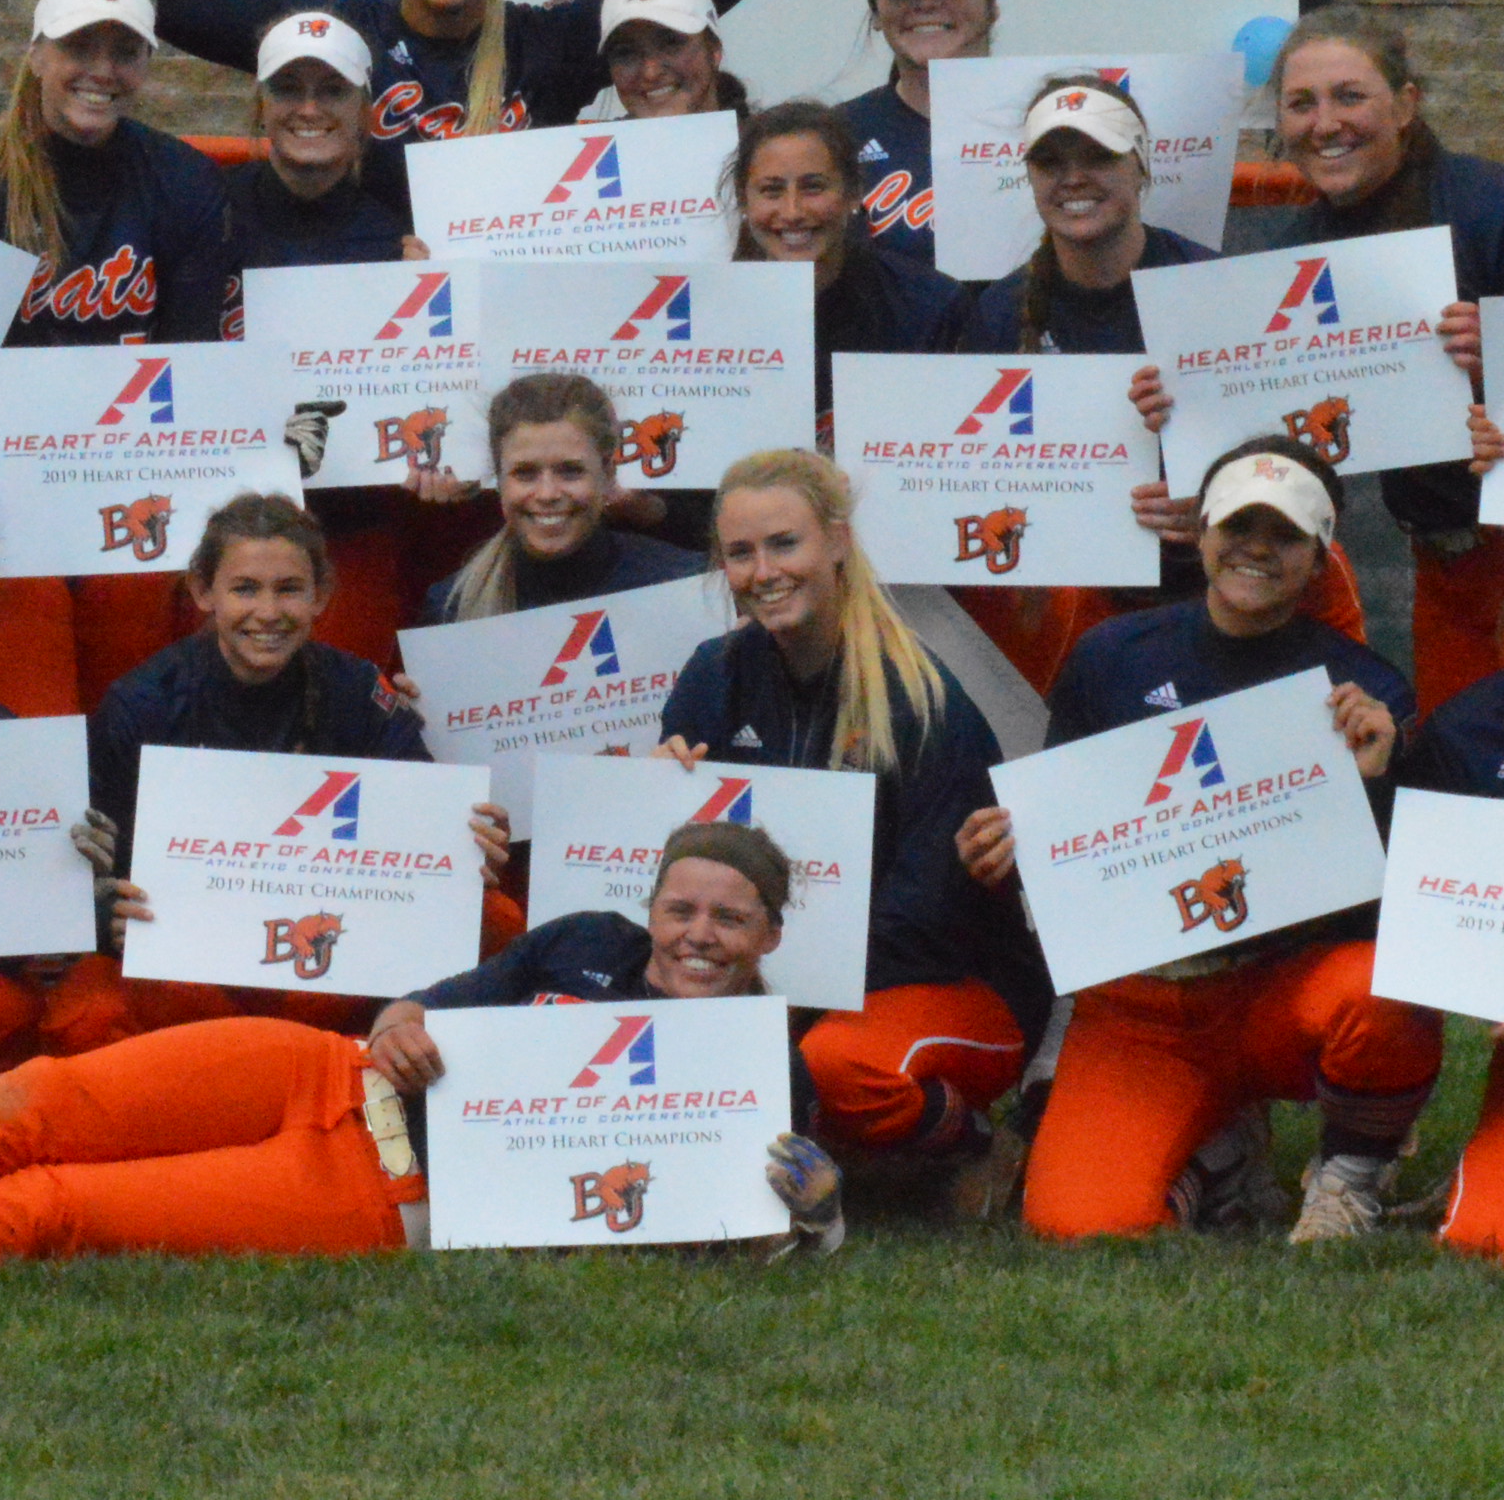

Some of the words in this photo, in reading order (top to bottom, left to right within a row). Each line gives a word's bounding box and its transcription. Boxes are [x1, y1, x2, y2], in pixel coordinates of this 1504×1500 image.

[449, 212, 544, 235] HEART
[551, 209, 578, 222] OF
[583, 197, 716, 223] AMERICA
[1178, 341, 1267, 370] HEART
[1274, 337, 1300, 352] OF
[1306, 319, 1430, 351] AMERICA
[291, 348, 374, 367] EART
[380, 346, 408, 359] OF
[512, 347, 610, 364] HEART
[617, 348, 645, 360] OF
[649, 348, 784, 365] AMERICA
[1223, 380, 1255, 396] 2019
[1259, 373, 1307, 391] HEART
[1313, 361, 1405, 382] CHAMPIONS
[317, 384, 352, 397] 2019
[358, 382, 408, 396] HEART
[651, 384, 751, 397] CHAMPIONS
[3, 433, 97, 452] HEART
[103, 432, 130, 445] OF
[135, 428, 266, 447] AMERICA
[863, 441, 954, 458] HEART
[961, 442, 988, 455] OF
[992, 443, 1129, 460] AMERICA
[43, 470, 77, 483] 2019
[83, 469, 131, 482] HEART
[138, 467, 235, 480] CHAMPIONS
[900, 478, 933, 491] 2019
[939, 478, 987, 491] HEART
[994, 479, 1094, 493] CHAMPIONS
[447, 695, 542, 727] HEART
[550, 689, 577, 705] OF
[584, 670, 678, 702] AMERI
[494, 735, 528, 752] 2019
[1050, 815, 1148, 860] HEART
[1155, 804, 1183, 824] OF
[1190, 763, 1325, 818] AMERICA
[167, 836, 271, 859] HEART
[277, 844, 308, 857] OF
[311, 847, 453, 871] AMERICA
[564, 844, 664, 864] HEART
[1102, 858, 1137, 880] 2019
[1142, 842, 1194, 868] HEART
[1201, 811, 1301, 848] CHAMPIONS
[206, 876, 245, 891] 2019
[251, 879, 303, 895] HEART
[311, 884, 414, 901] CHAMPIONS
[604, 882, 643, 898] 2019
[1456, 916, 1495, 931] 2019
[463, 1096, 568, 1117] HEART
[576, 1095, 606, 1109] OF
[611, 1090, 757, 1111] AMERICA
[508, 1136, 546, 1151] 2019
[552, 1135, 606, 1149] HEART
[614, 1131, 722, 1145] CHAMPIONS
